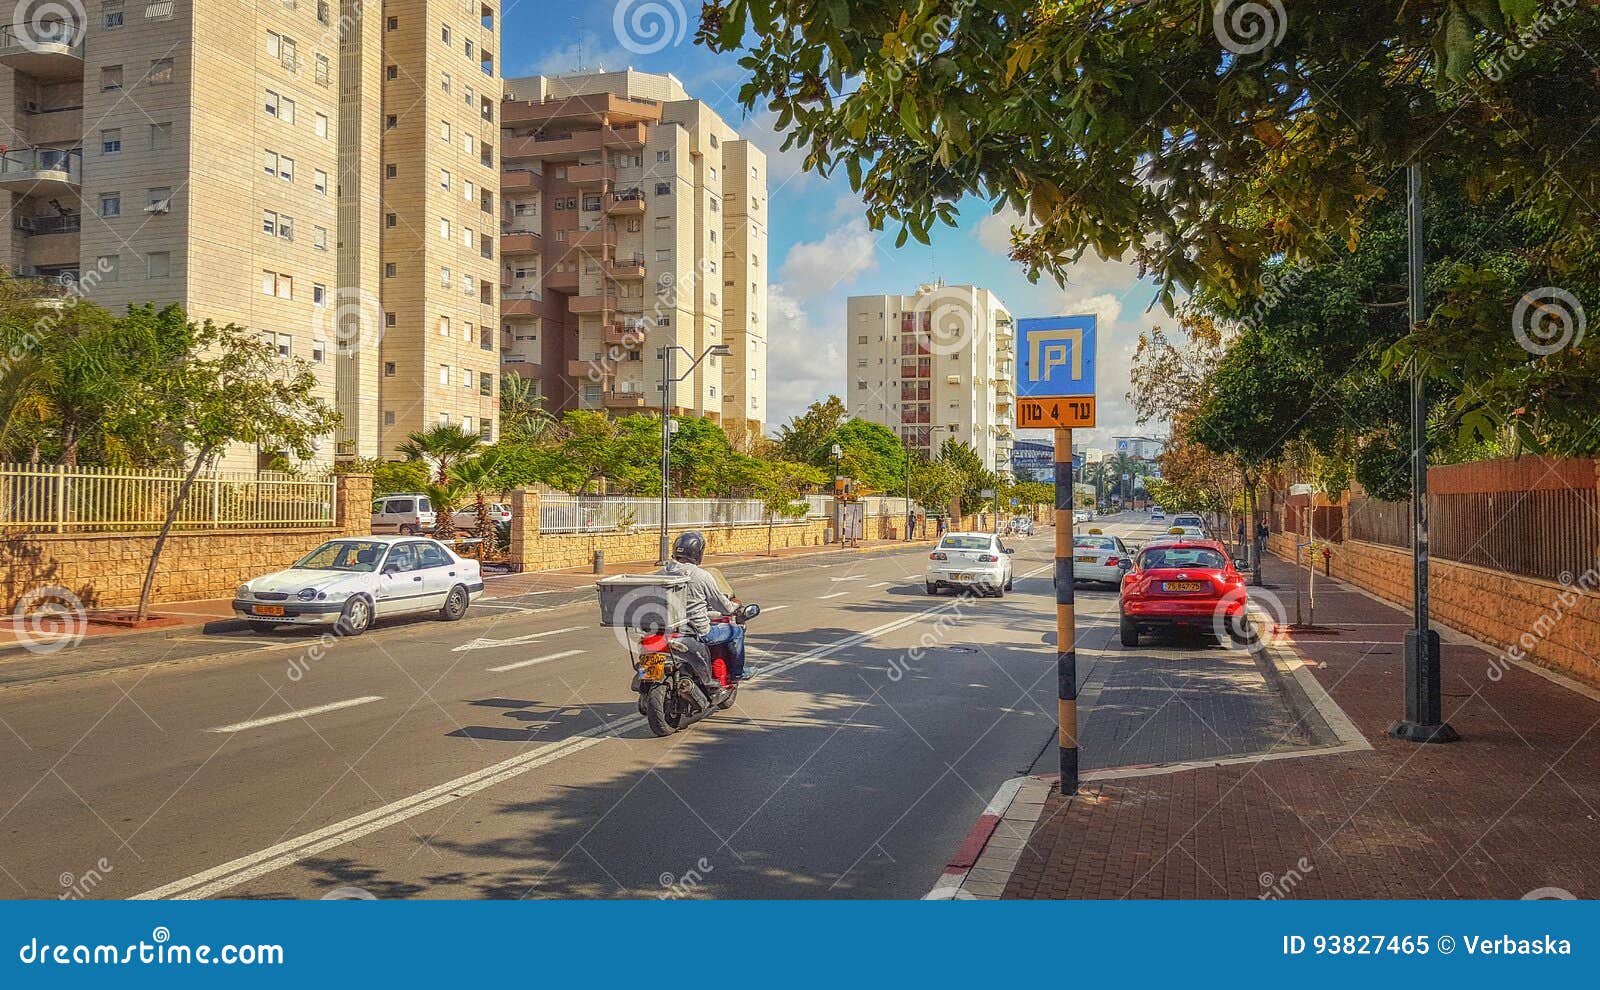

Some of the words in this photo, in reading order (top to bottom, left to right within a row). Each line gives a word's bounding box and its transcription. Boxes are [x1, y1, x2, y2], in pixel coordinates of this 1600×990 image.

[1021, 403, 1042, 425] טון
[1051, 403, 1059, 420] 4
[1069, 402, 1091, 420] עד
